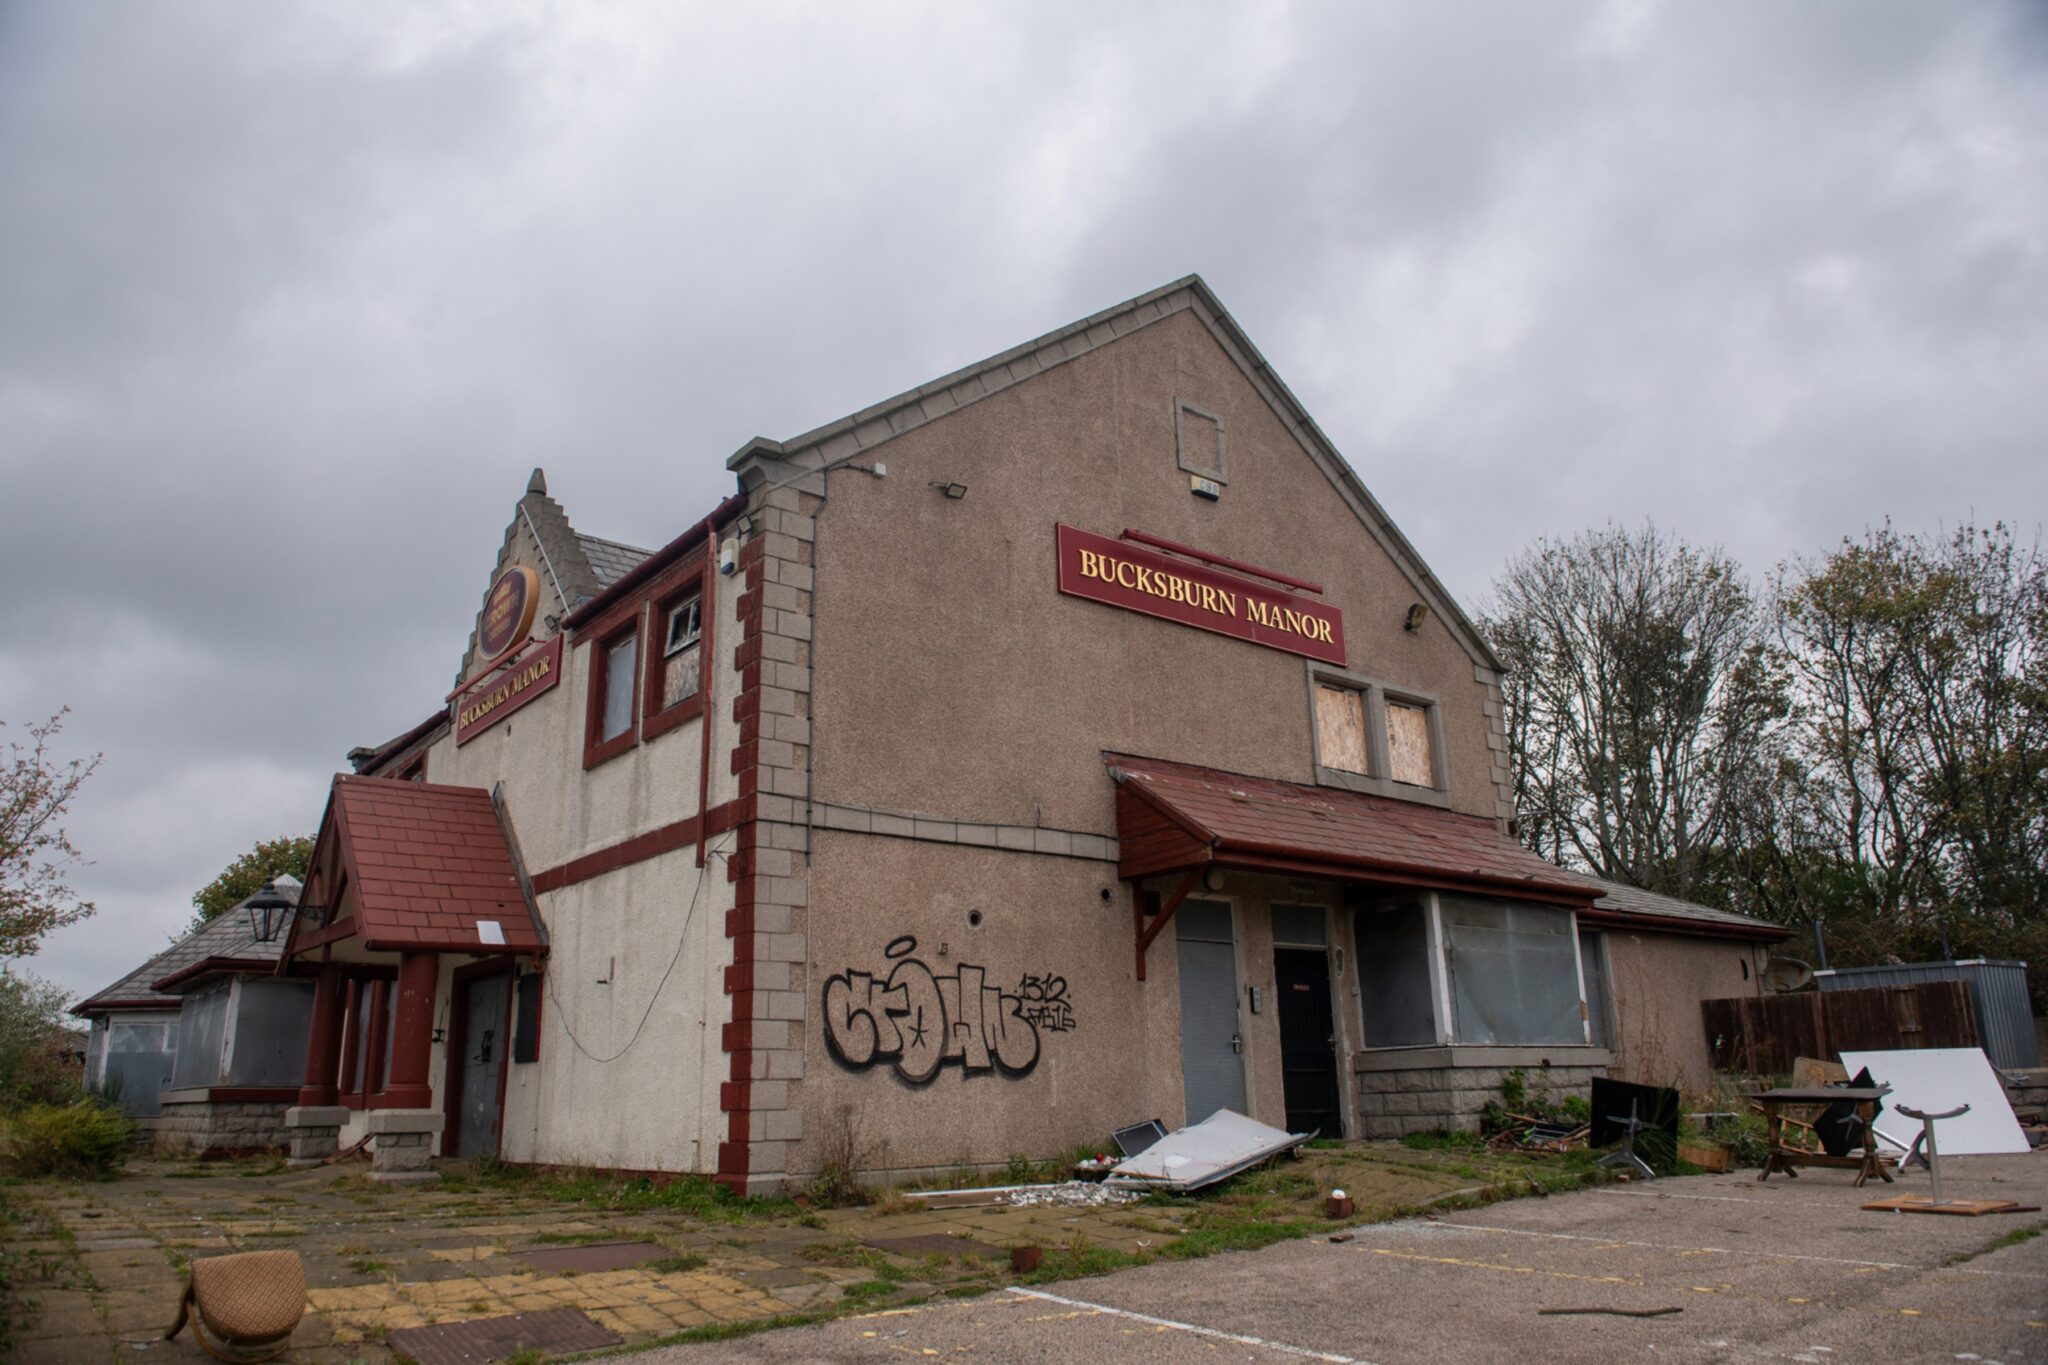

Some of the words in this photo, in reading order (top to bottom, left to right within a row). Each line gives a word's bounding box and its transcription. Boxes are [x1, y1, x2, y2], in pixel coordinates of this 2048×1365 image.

[1079, 549, 1236, 617] BUCKSBURN
[1245, 597, 1334, 643] MANOR
[459, 692, 511, 730] BUCKSBURN
[512, 656, 550, 694] MANOR
